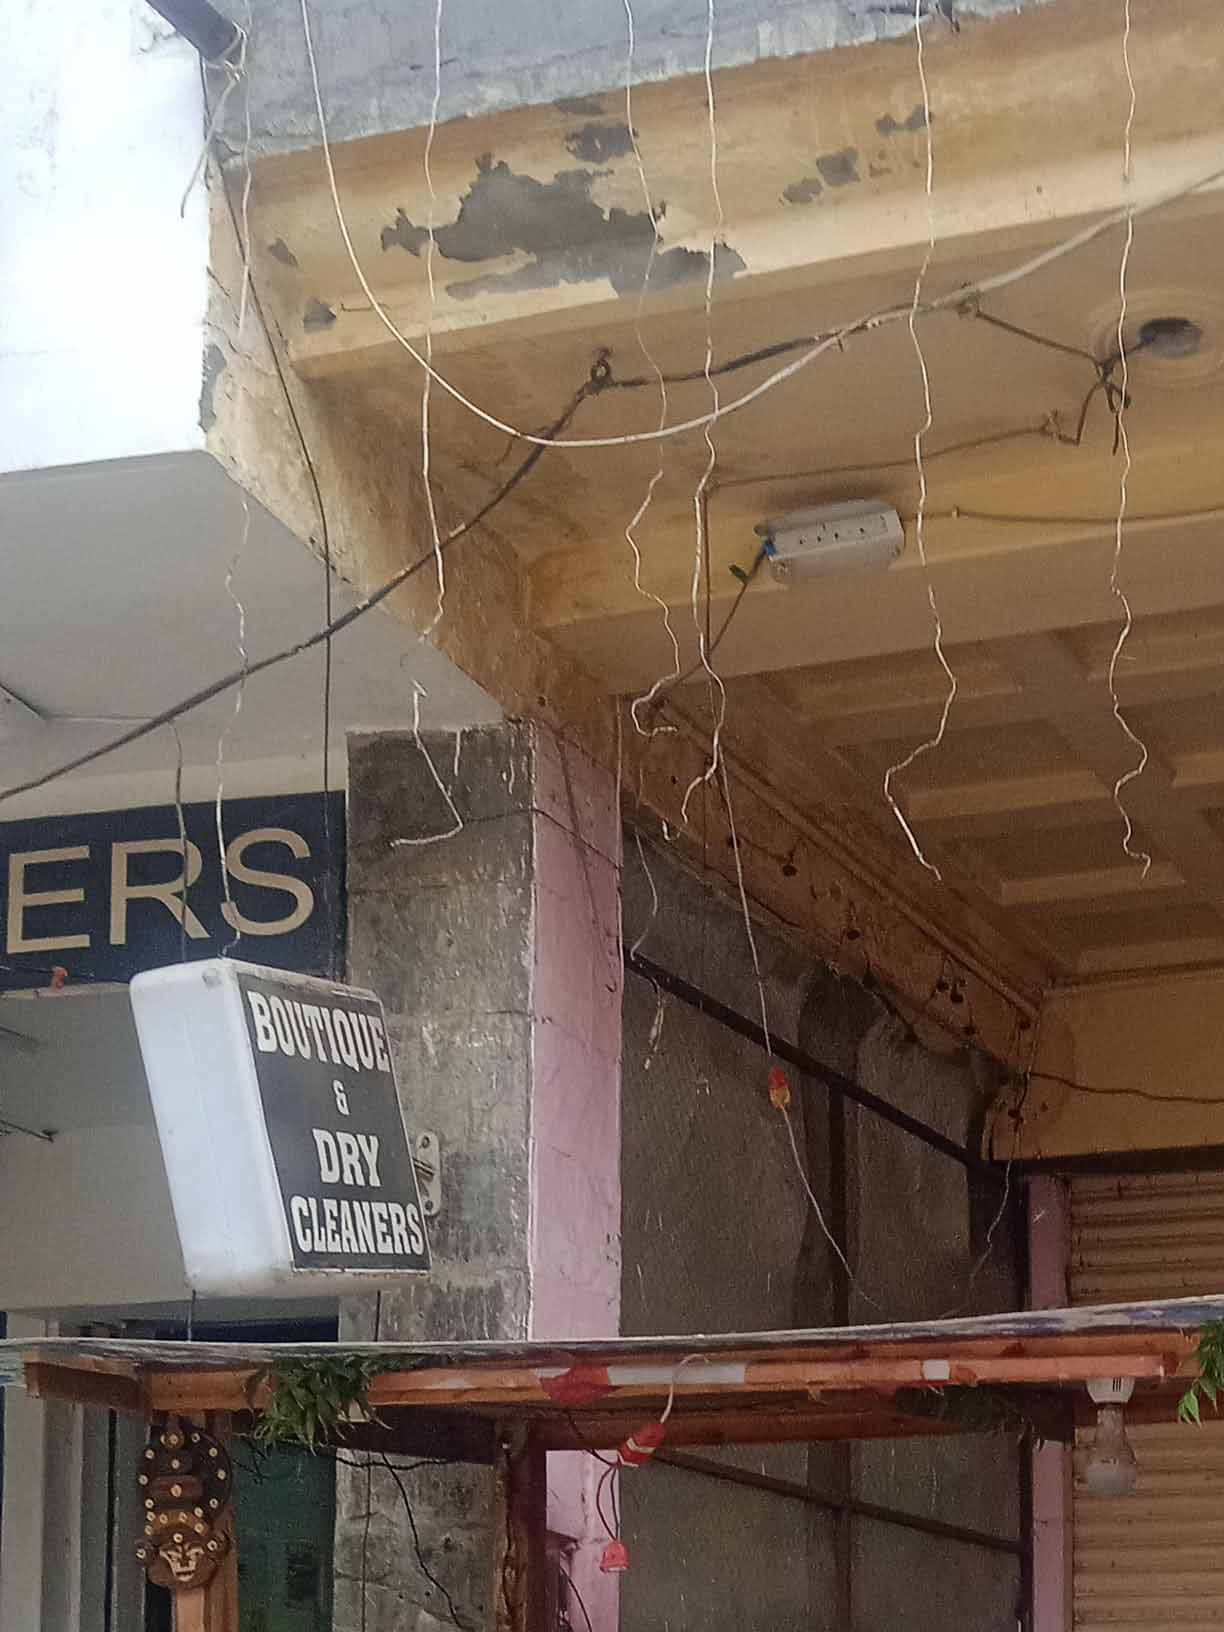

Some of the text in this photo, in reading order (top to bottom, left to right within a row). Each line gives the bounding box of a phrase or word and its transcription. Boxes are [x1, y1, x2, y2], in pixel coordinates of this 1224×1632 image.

[6, 828, 314, 954] ERS
[247, 990, 391, 1073] BOUTIQUE
[332, 1079, 350, 1116] &
[312, 1128, 382, 1188] DRY
[290, 1195, 425, 1255] CLEANERS
